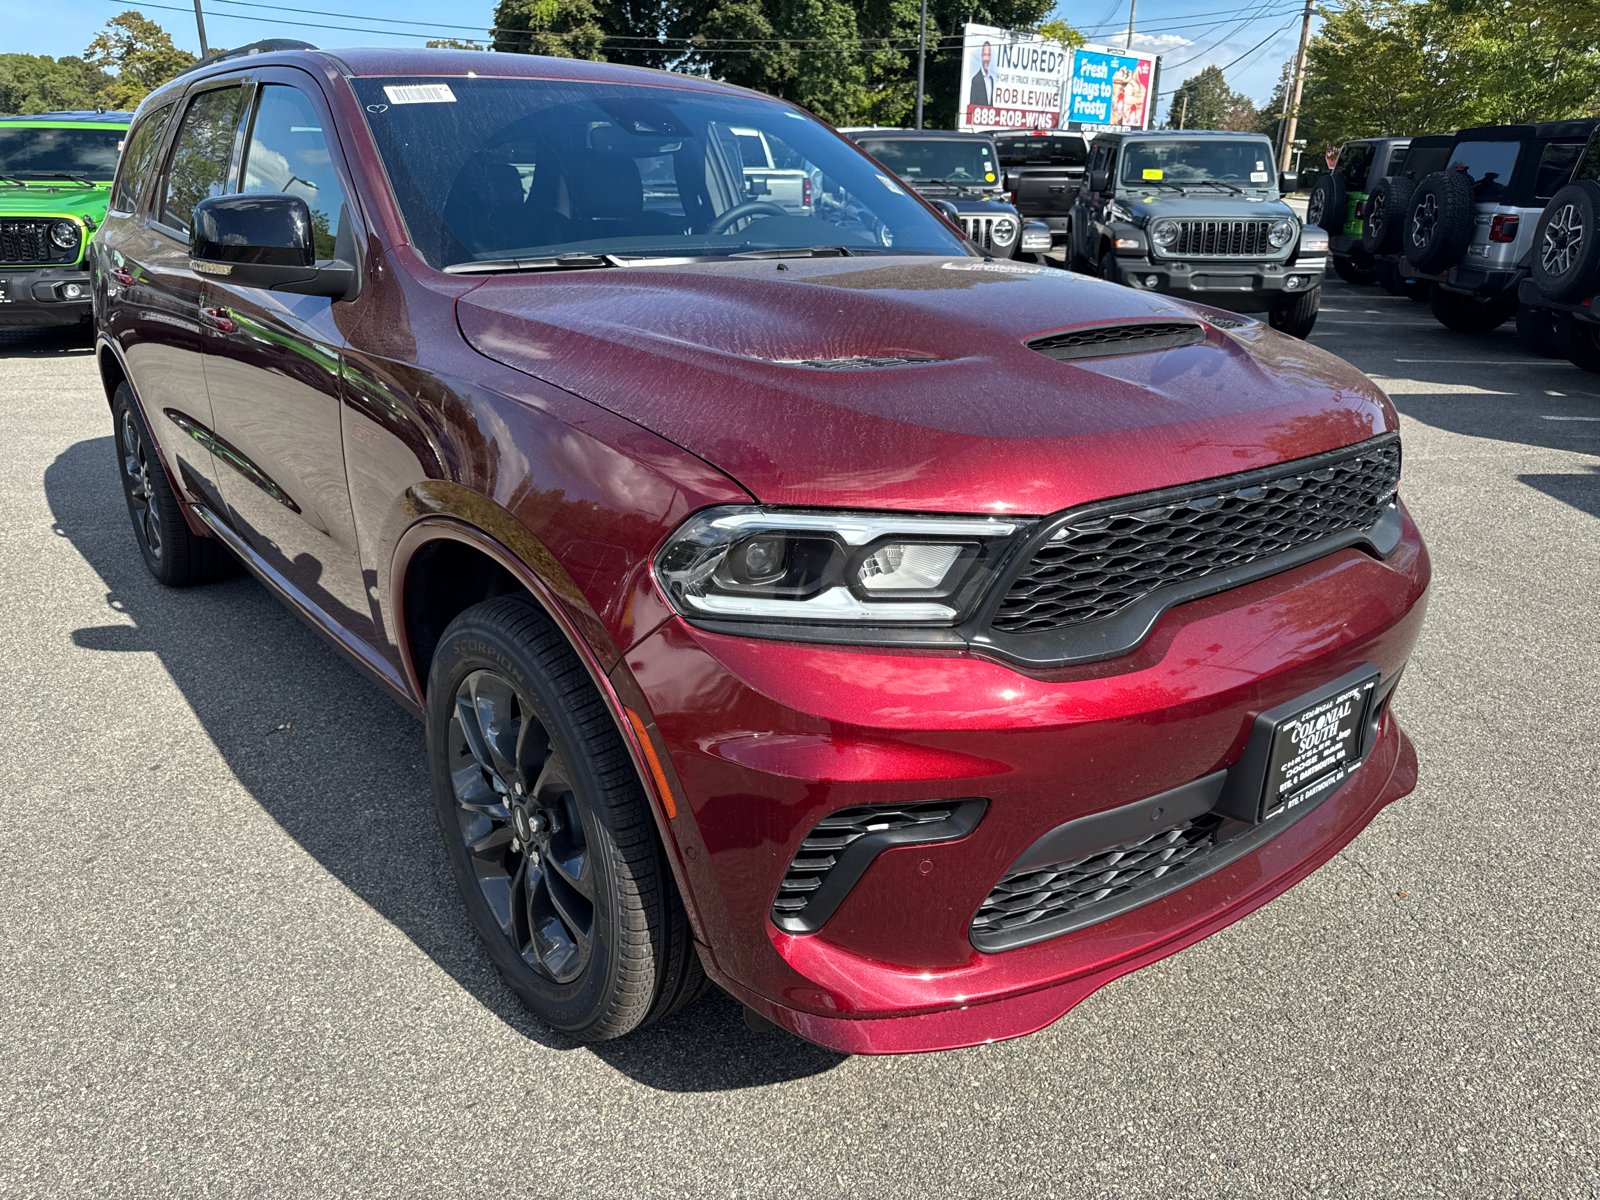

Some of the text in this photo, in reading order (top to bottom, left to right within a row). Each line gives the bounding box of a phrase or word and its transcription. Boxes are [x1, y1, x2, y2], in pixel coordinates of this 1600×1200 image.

[997, 44, 1063, 74] INJURED?
[1080, 58, 1108, 79] Fresh
[1000, 73, 1009, 83] CAR
[1073, 77, 1111, 101] Ways to
[995, 87, 1059, 107] ROB LEVINE
[1073, 96, 1107, 120] Frosty
[973, 107, 1053, 129] 888-ROB-WINS
[351, 421, 381, 447] GT
[453, 639, 524, 683] SCORPION
[1291, 701, 1352, 744] COLONIAL
[1281, 740, 1331, 771] CHRYSLER
[1336, 728, 1352, 741] Jeep
[1298, 720, 1340, 754] SOUTH
[1286, 742, 1343, 778] DODGE RAM
[1293, 776, 1298, 784] 6
[1337, 749, 1346, 760] MA
